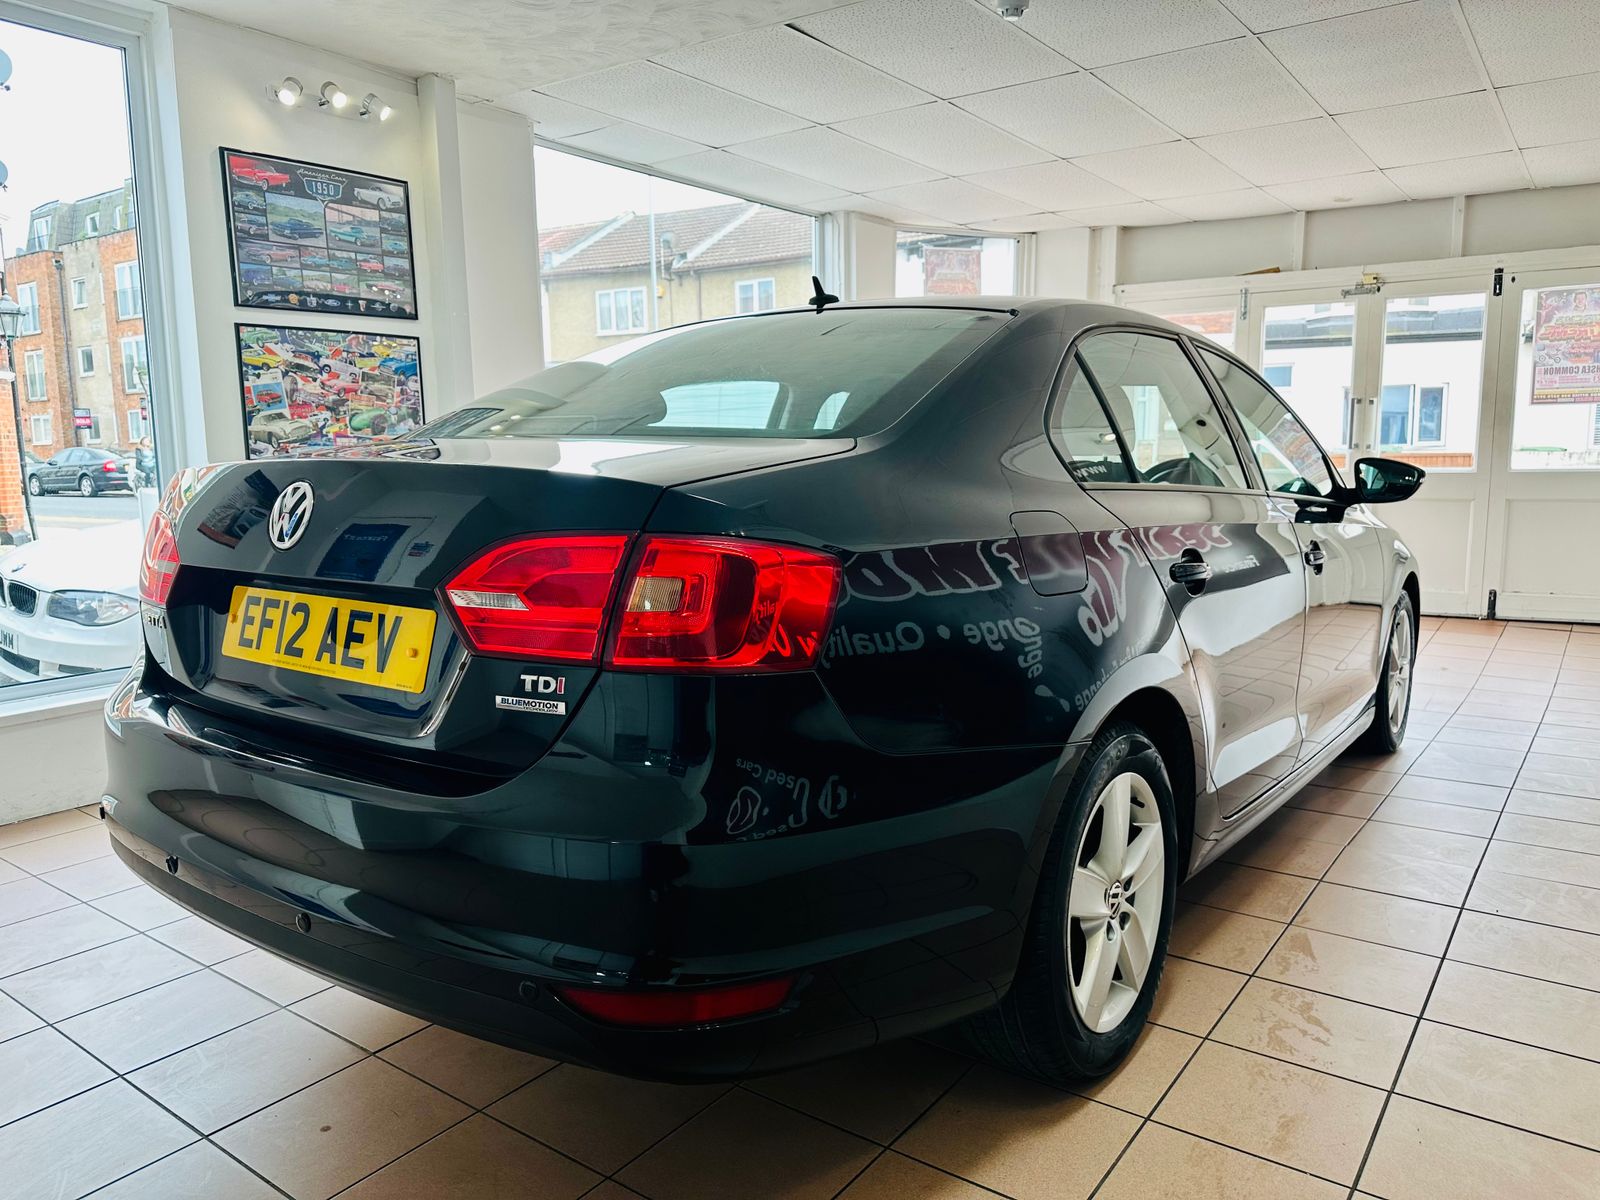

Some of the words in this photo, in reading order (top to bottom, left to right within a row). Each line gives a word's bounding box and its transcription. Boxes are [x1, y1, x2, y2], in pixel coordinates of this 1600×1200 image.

[312, 181, 335, 196] 1950
[238, 596, 311, 659] EF12
[314, 607, 403, 675] AEV
[520, 674, 566, 695] TDI
[500, 697, 559, 711] BLUEMOTION
